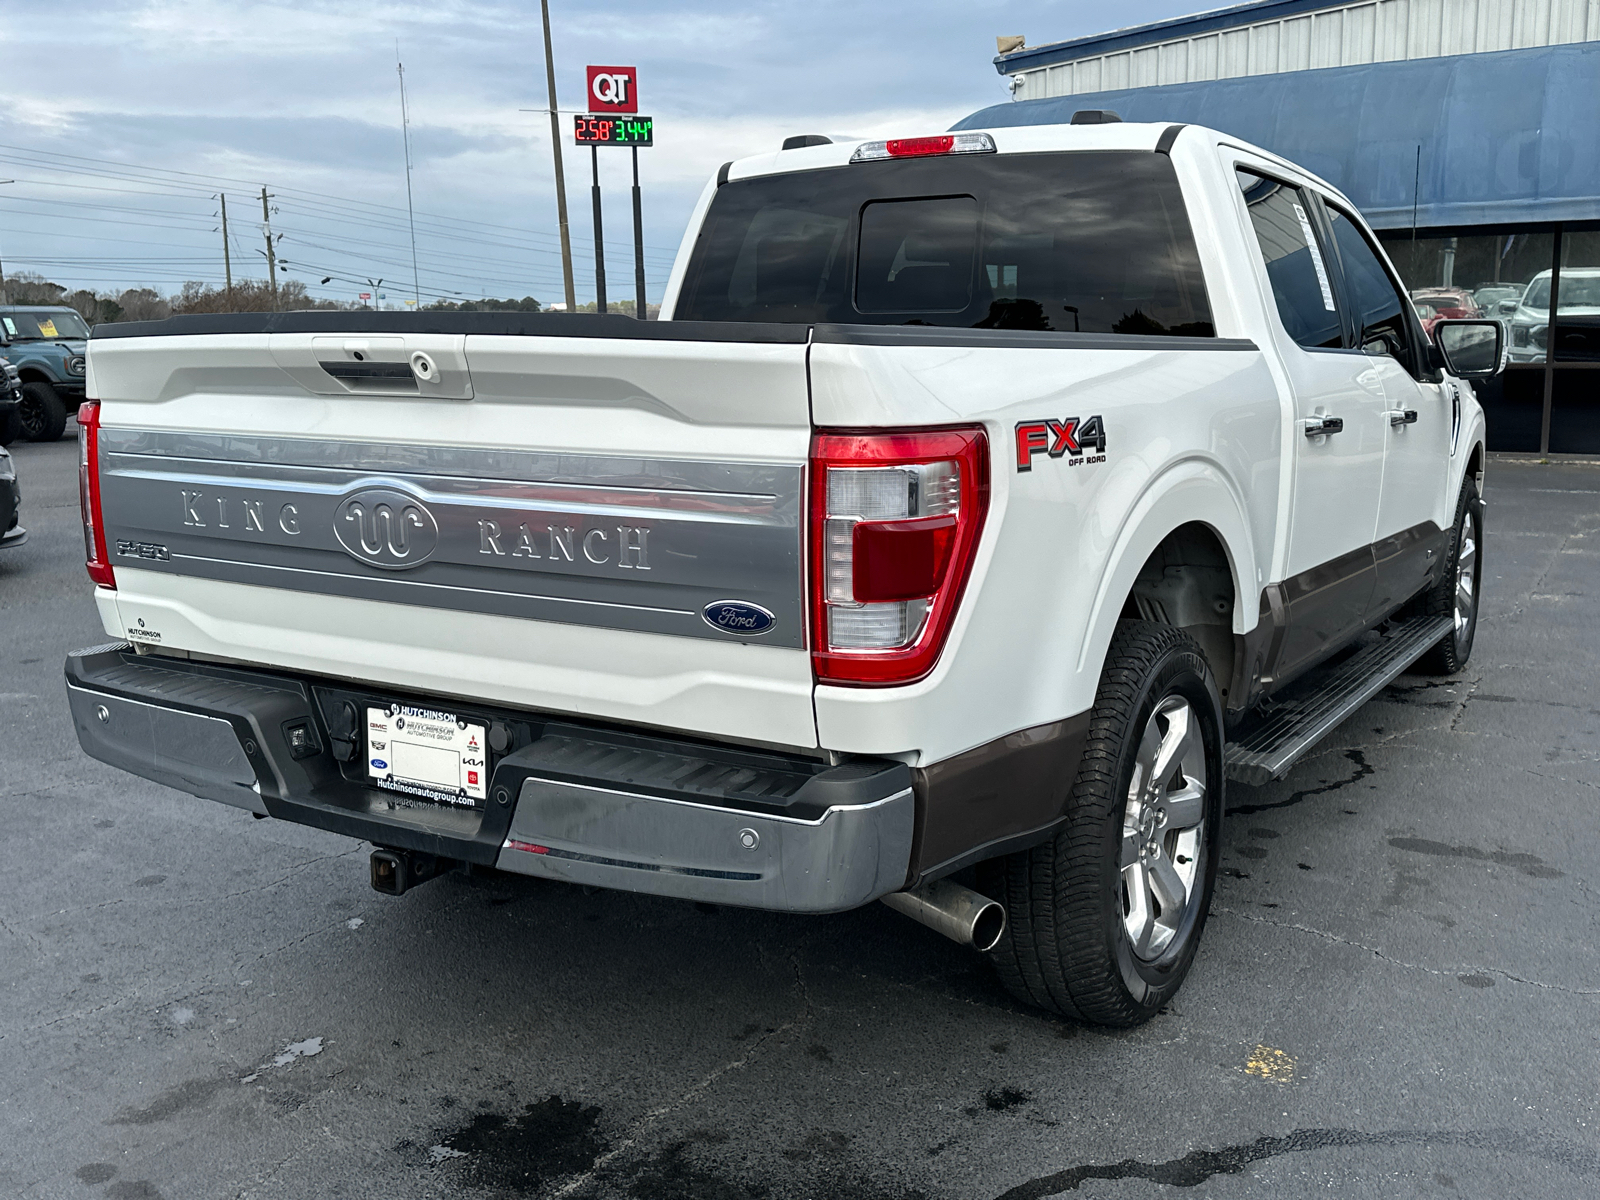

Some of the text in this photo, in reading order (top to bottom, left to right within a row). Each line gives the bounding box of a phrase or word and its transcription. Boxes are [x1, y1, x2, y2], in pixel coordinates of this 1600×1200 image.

[592, 73, 632, 106] QT
[1014, 415, 1106, 473] FX4
[1069, 455, 1107, 467] OFF ROAD
[181, 489, 301, 535] KING
[477, 518, 652, 570] RANCH
[128, 628, 161, 638] HUTCHINSON
[401, 706, 456, 723] HUTCHINSON
[370, 722, 387, 730] GMC
[377, 778, 475, 806] Hutchinsonautogroup.com
